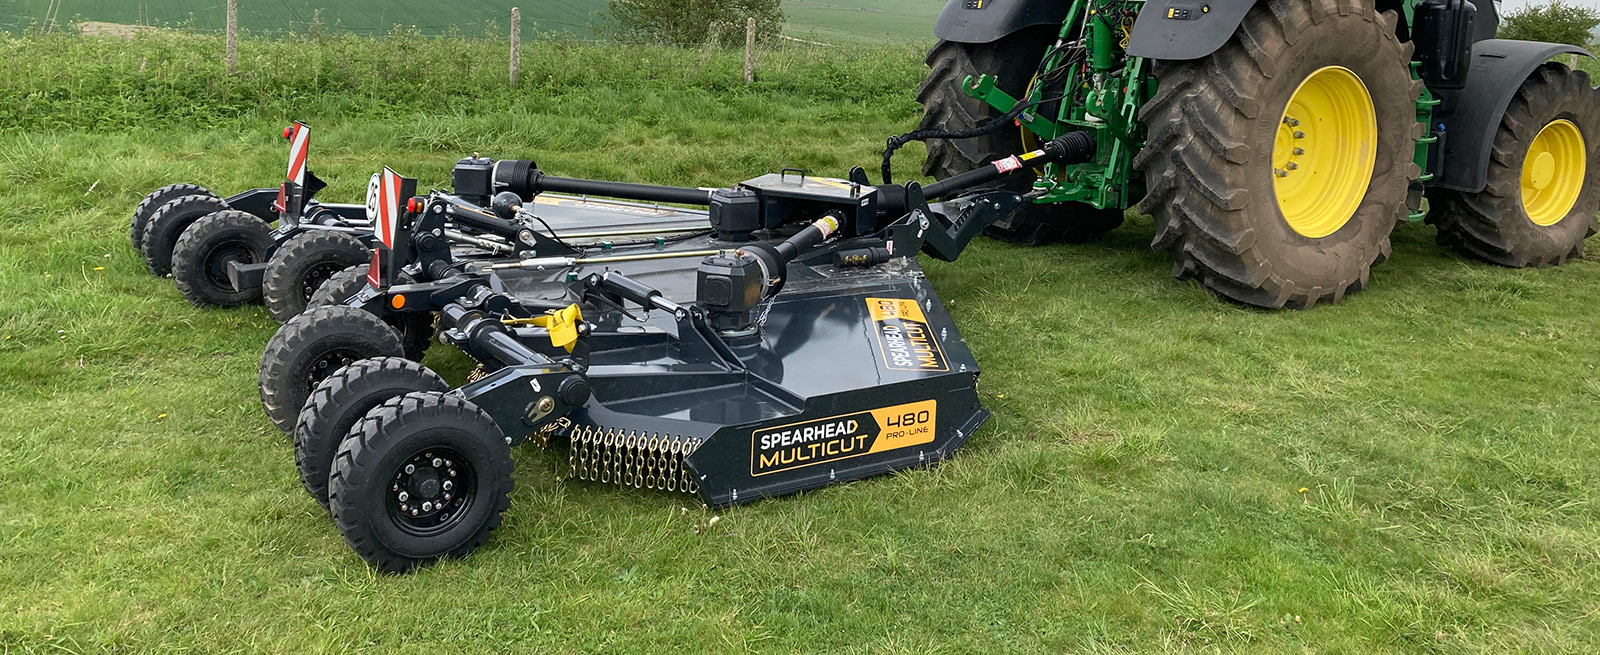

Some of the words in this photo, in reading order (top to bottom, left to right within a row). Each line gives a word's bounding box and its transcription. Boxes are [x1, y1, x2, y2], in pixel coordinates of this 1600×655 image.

[369, 182, 378, 212] 25
[878, 300, 895, 317] 480
[882, 325, 914, 367] SPEARHEAD
[902, 322, 939, 368] MULTICUT
[885, 425, 929, 440] PRO-LINE
[887, 410, 930, 428] 480
[760, 419, 859, 450] SPEARHEAD
[759, 434, 869, 469] MULTICUT
